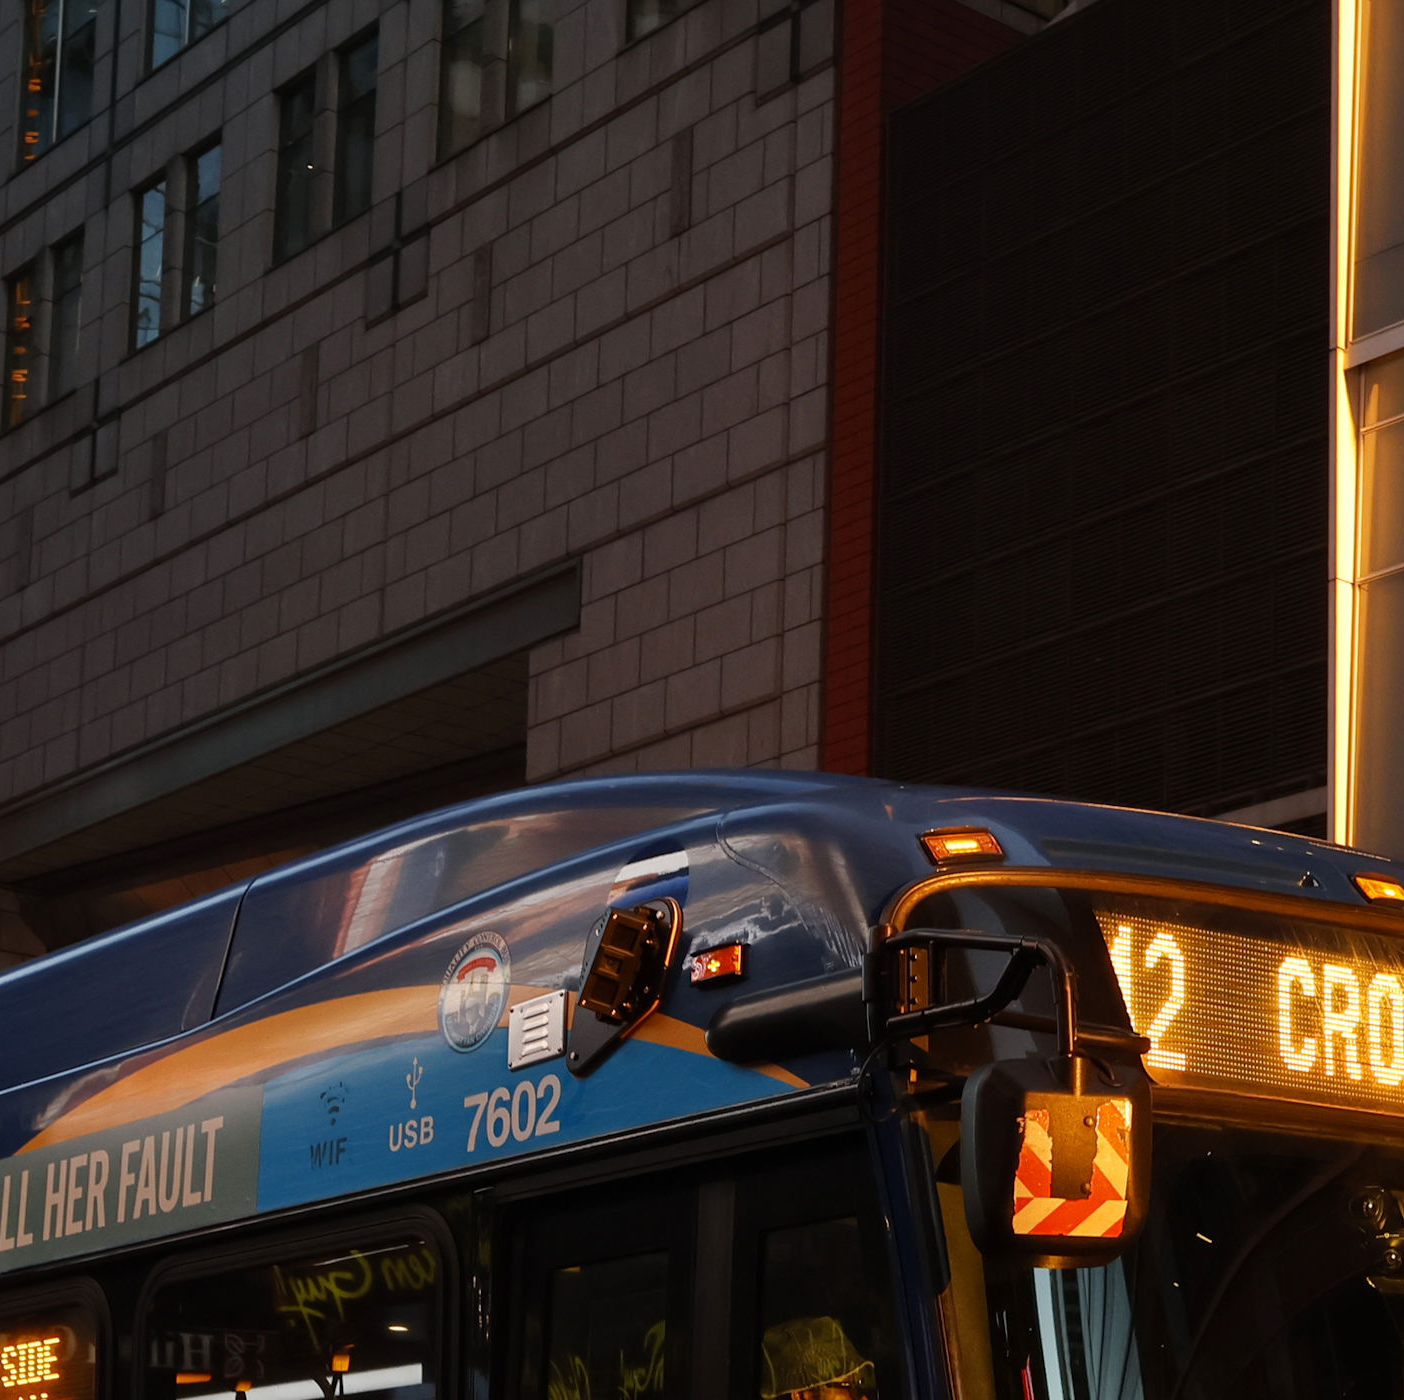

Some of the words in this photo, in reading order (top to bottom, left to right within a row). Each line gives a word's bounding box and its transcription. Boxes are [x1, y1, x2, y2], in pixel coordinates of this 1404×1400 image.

[389, 1115, 434, 1153] USB
[464, 1074, 561, 1153] 7602
[42, 1149, 109, 1241] HER
[116, 1116, 224, 1222] FAULT
[1, 1337, 60, 1388] SIDE
